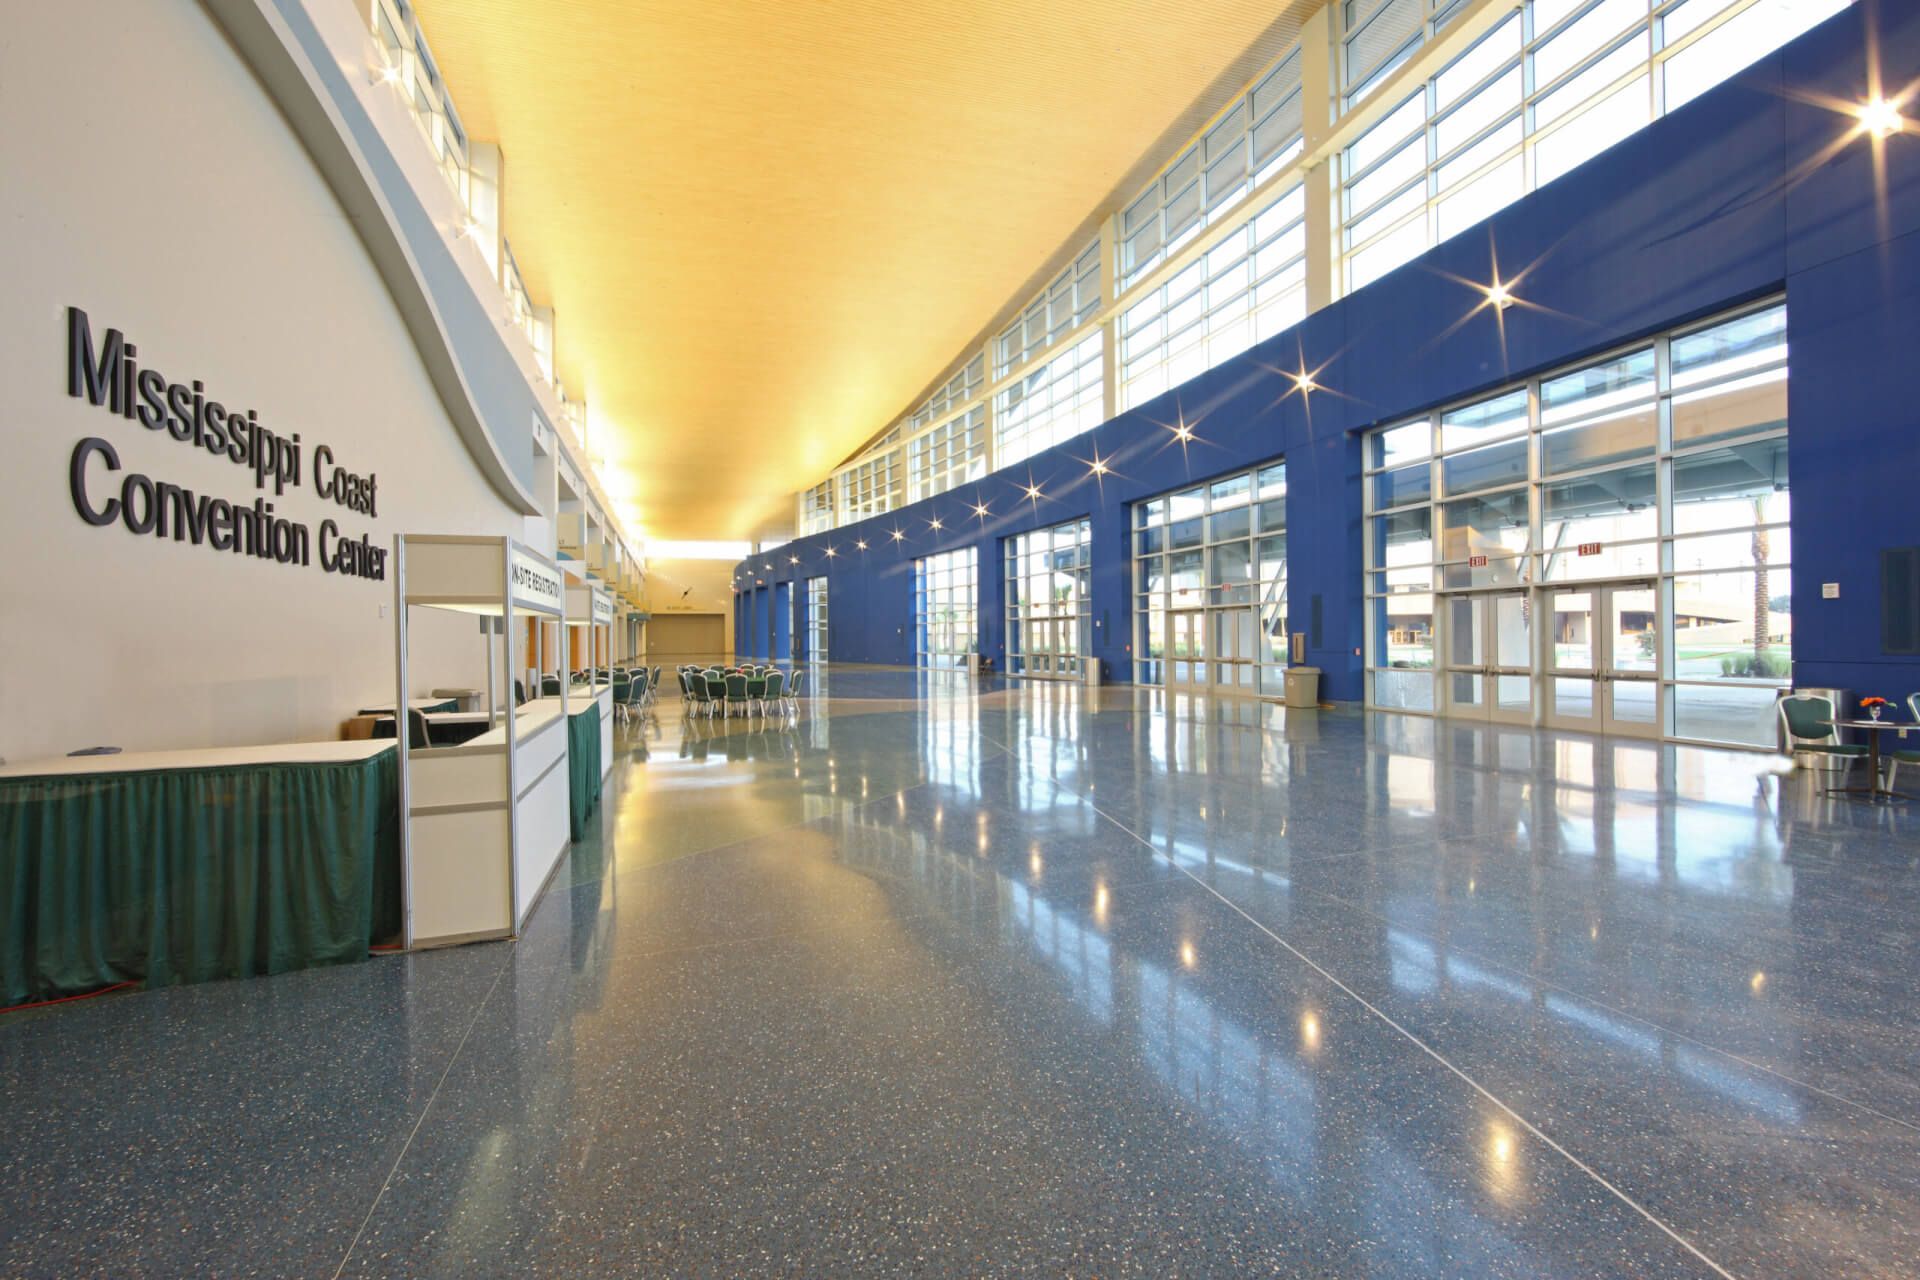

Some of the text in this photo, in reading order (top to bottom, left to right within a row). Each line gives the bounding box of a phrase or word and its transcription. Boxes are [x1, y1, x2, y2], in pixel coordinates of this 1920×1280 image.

[68, 306, 377, 518] Mississippi Coast
[70, 437, 387, 581] Convention Center
[1471, 556, 1487, 567] EXIT
[1582, 543, 1599, 555] EXIT
[532, 572, 560, 598] REGISTRATIO
